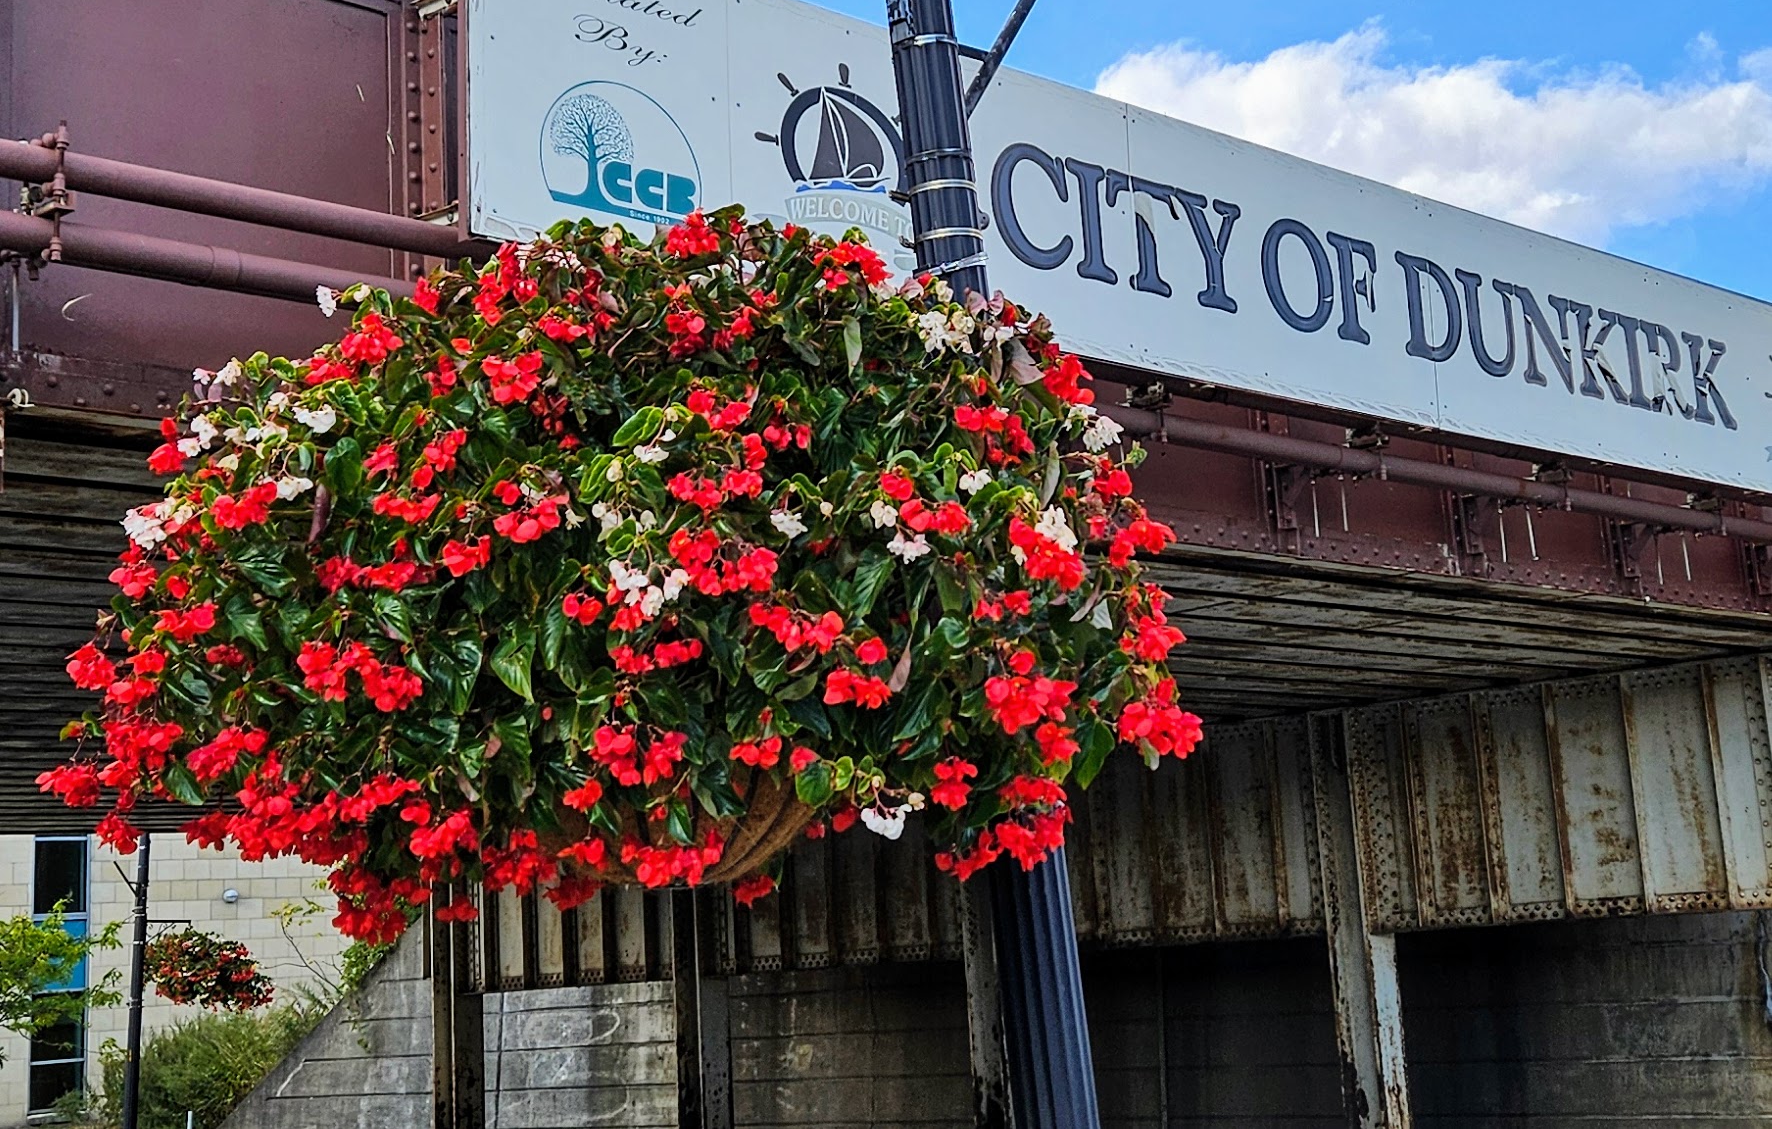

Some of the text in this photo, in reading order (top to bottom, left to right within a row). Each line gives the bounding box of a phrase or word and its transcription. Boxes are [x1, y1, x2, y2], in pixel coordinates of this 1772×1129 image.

[573, 13, 667, 67] By:
[602, 160, 697, 216] CCB
[790, 196, 890, 232] WELCOME
[629, 210, 670, 225] Since 1902
[991, 142, 1738, 432] CITY OF DUNKIRK
